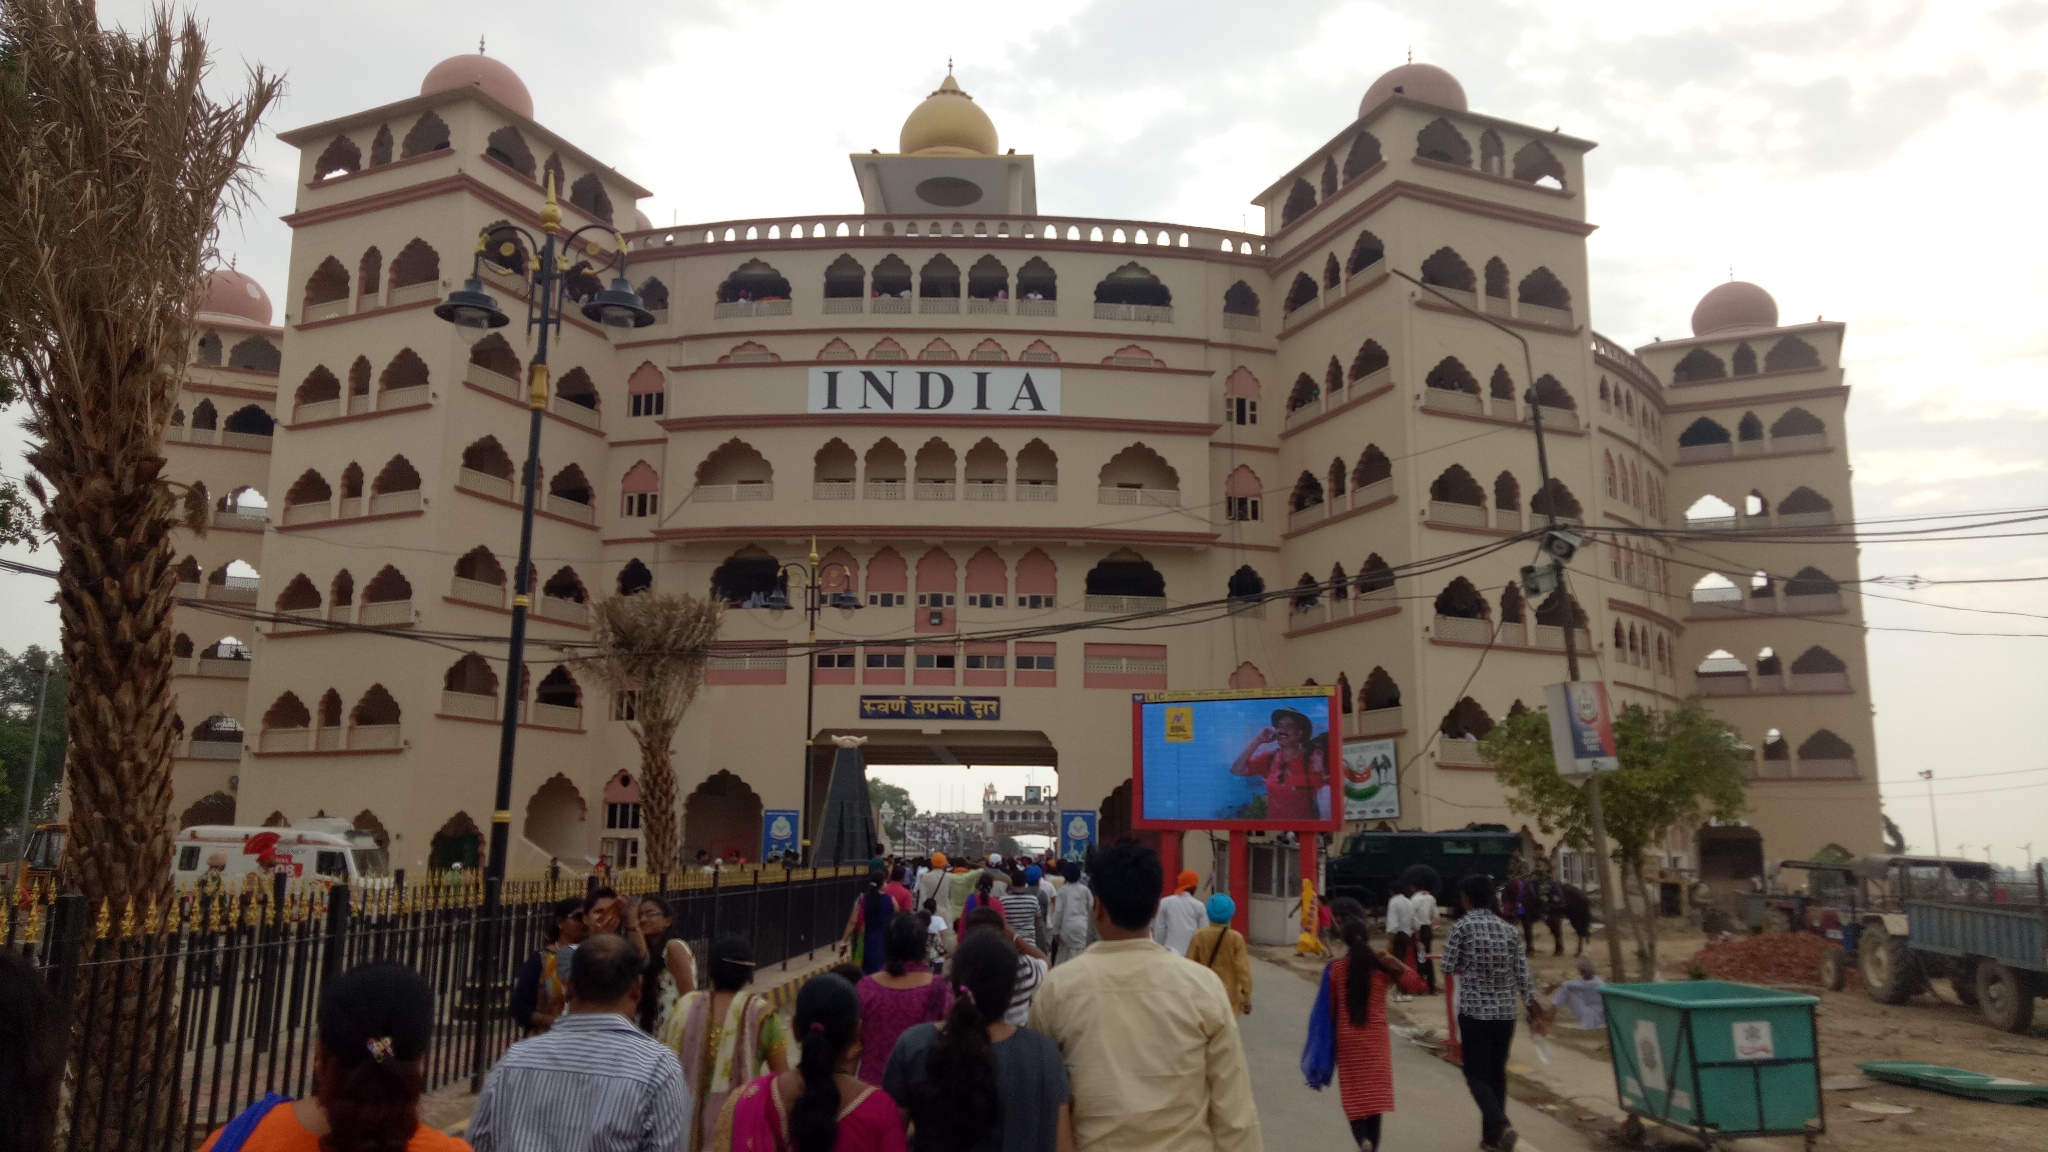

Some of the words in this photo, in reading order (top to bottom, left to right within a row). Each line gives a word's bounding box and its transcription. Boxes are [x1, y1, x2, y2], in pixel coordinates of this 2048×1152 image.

[822, 370, 1048, 412] INDIA
[862, 696, 907, 715] स्वर्ण
[910, 696, 967, 716] जयन्ती
[969, 699, 999, 719] द्वार
[1147, 692, 1165, 702] LIC
